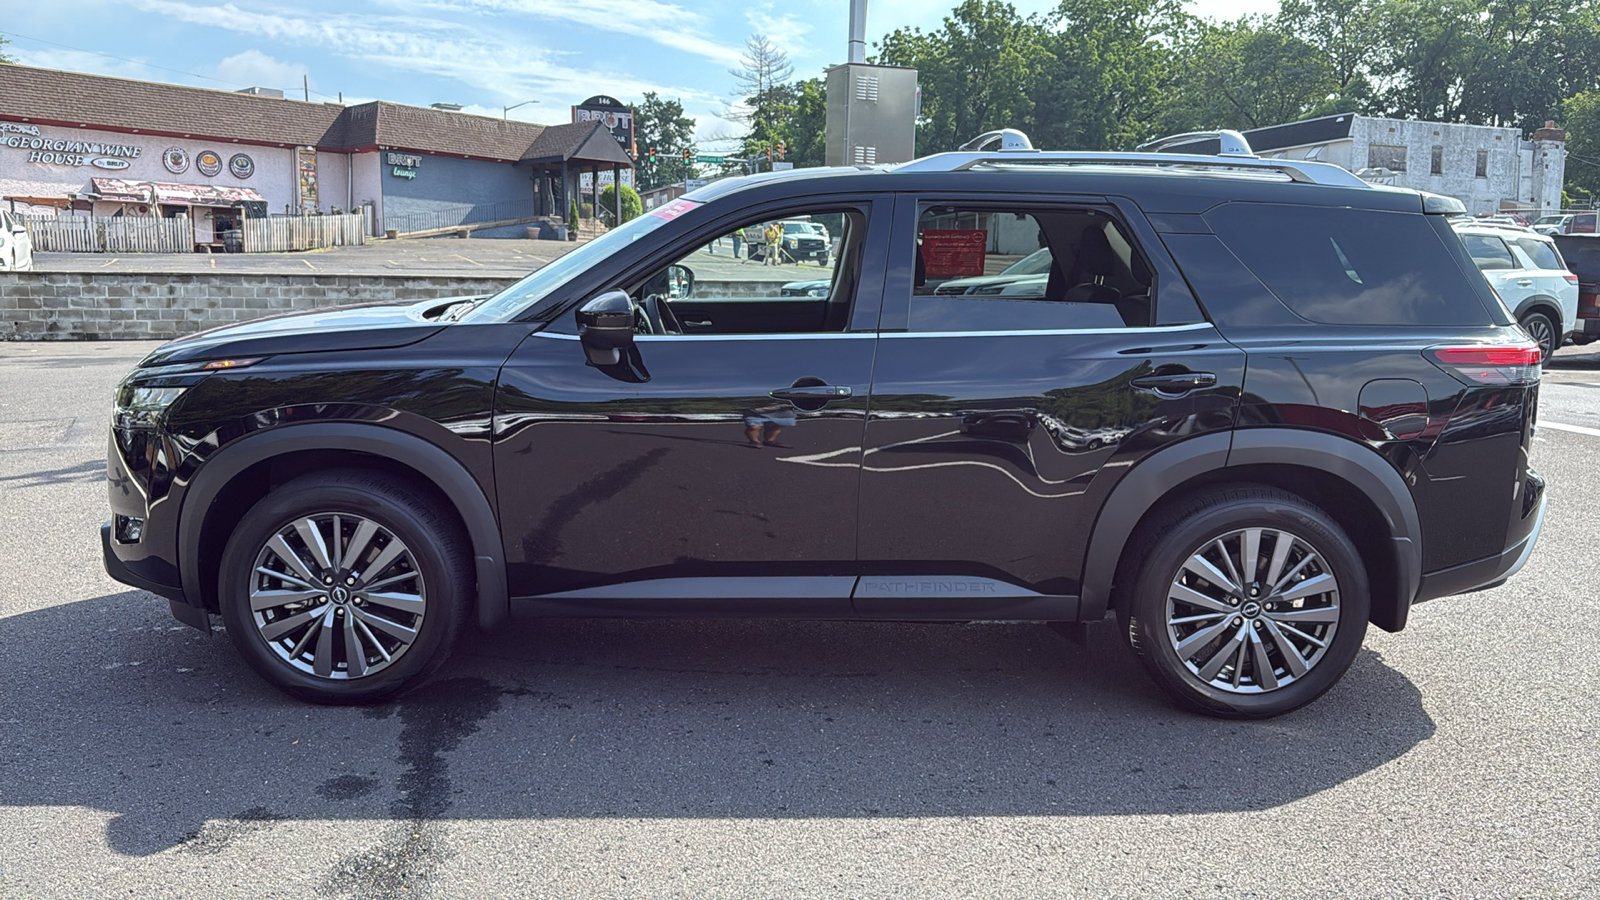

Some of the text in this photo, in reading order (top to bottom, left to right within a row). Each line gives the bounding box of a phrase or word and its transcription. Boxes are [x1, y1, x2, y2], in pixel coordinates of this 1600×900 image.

[598, 97, 611, 105] 146
[577, 109, 632, 129] BRUT
[7, 136, 142, 158] GEORGIAN WINE
[28, 151, 84, 166] HOUSE
[387, 152, 423, 168] BRUT
[603, 174, 630, 182] HOSE
[864, 582, 996, 592] PATHFINDER
